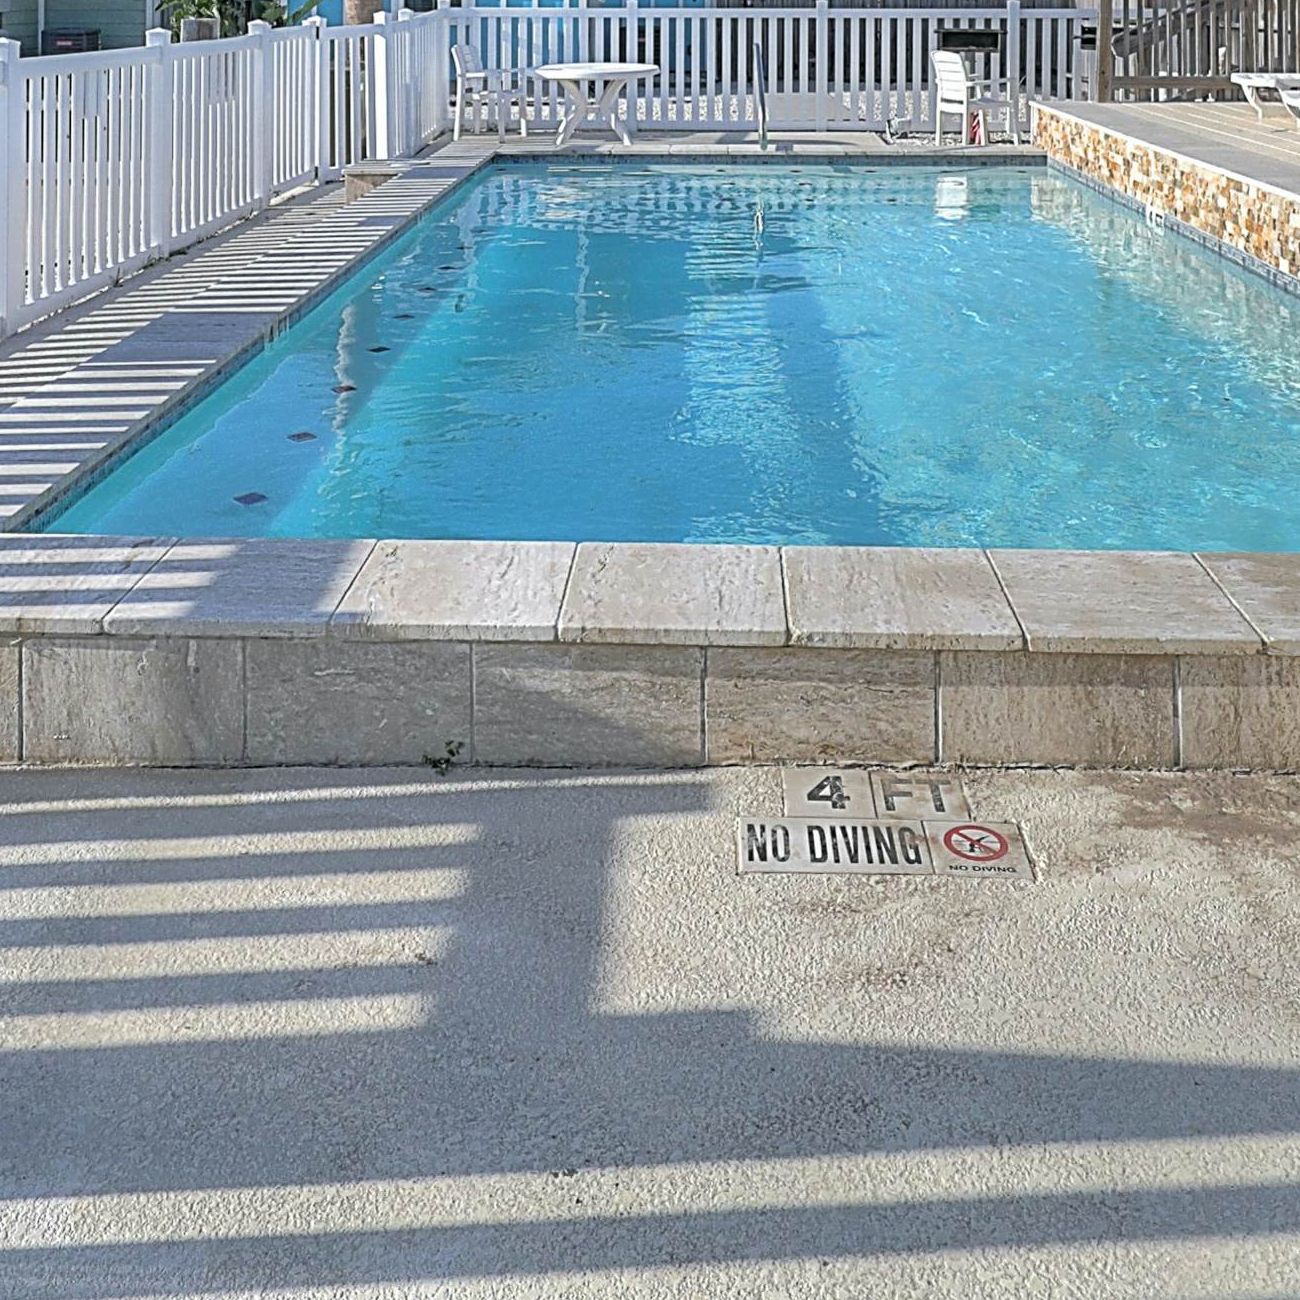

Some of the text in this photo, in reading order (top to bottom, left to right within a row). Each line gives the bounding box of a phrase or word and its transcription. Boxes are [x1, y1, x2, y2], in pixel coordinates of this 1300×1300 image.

[807, 775, 951, 813] 4 FT
[747, 824, 923, 865] NO DIVING
[948, 864, 1017, 874] NO DIVING
